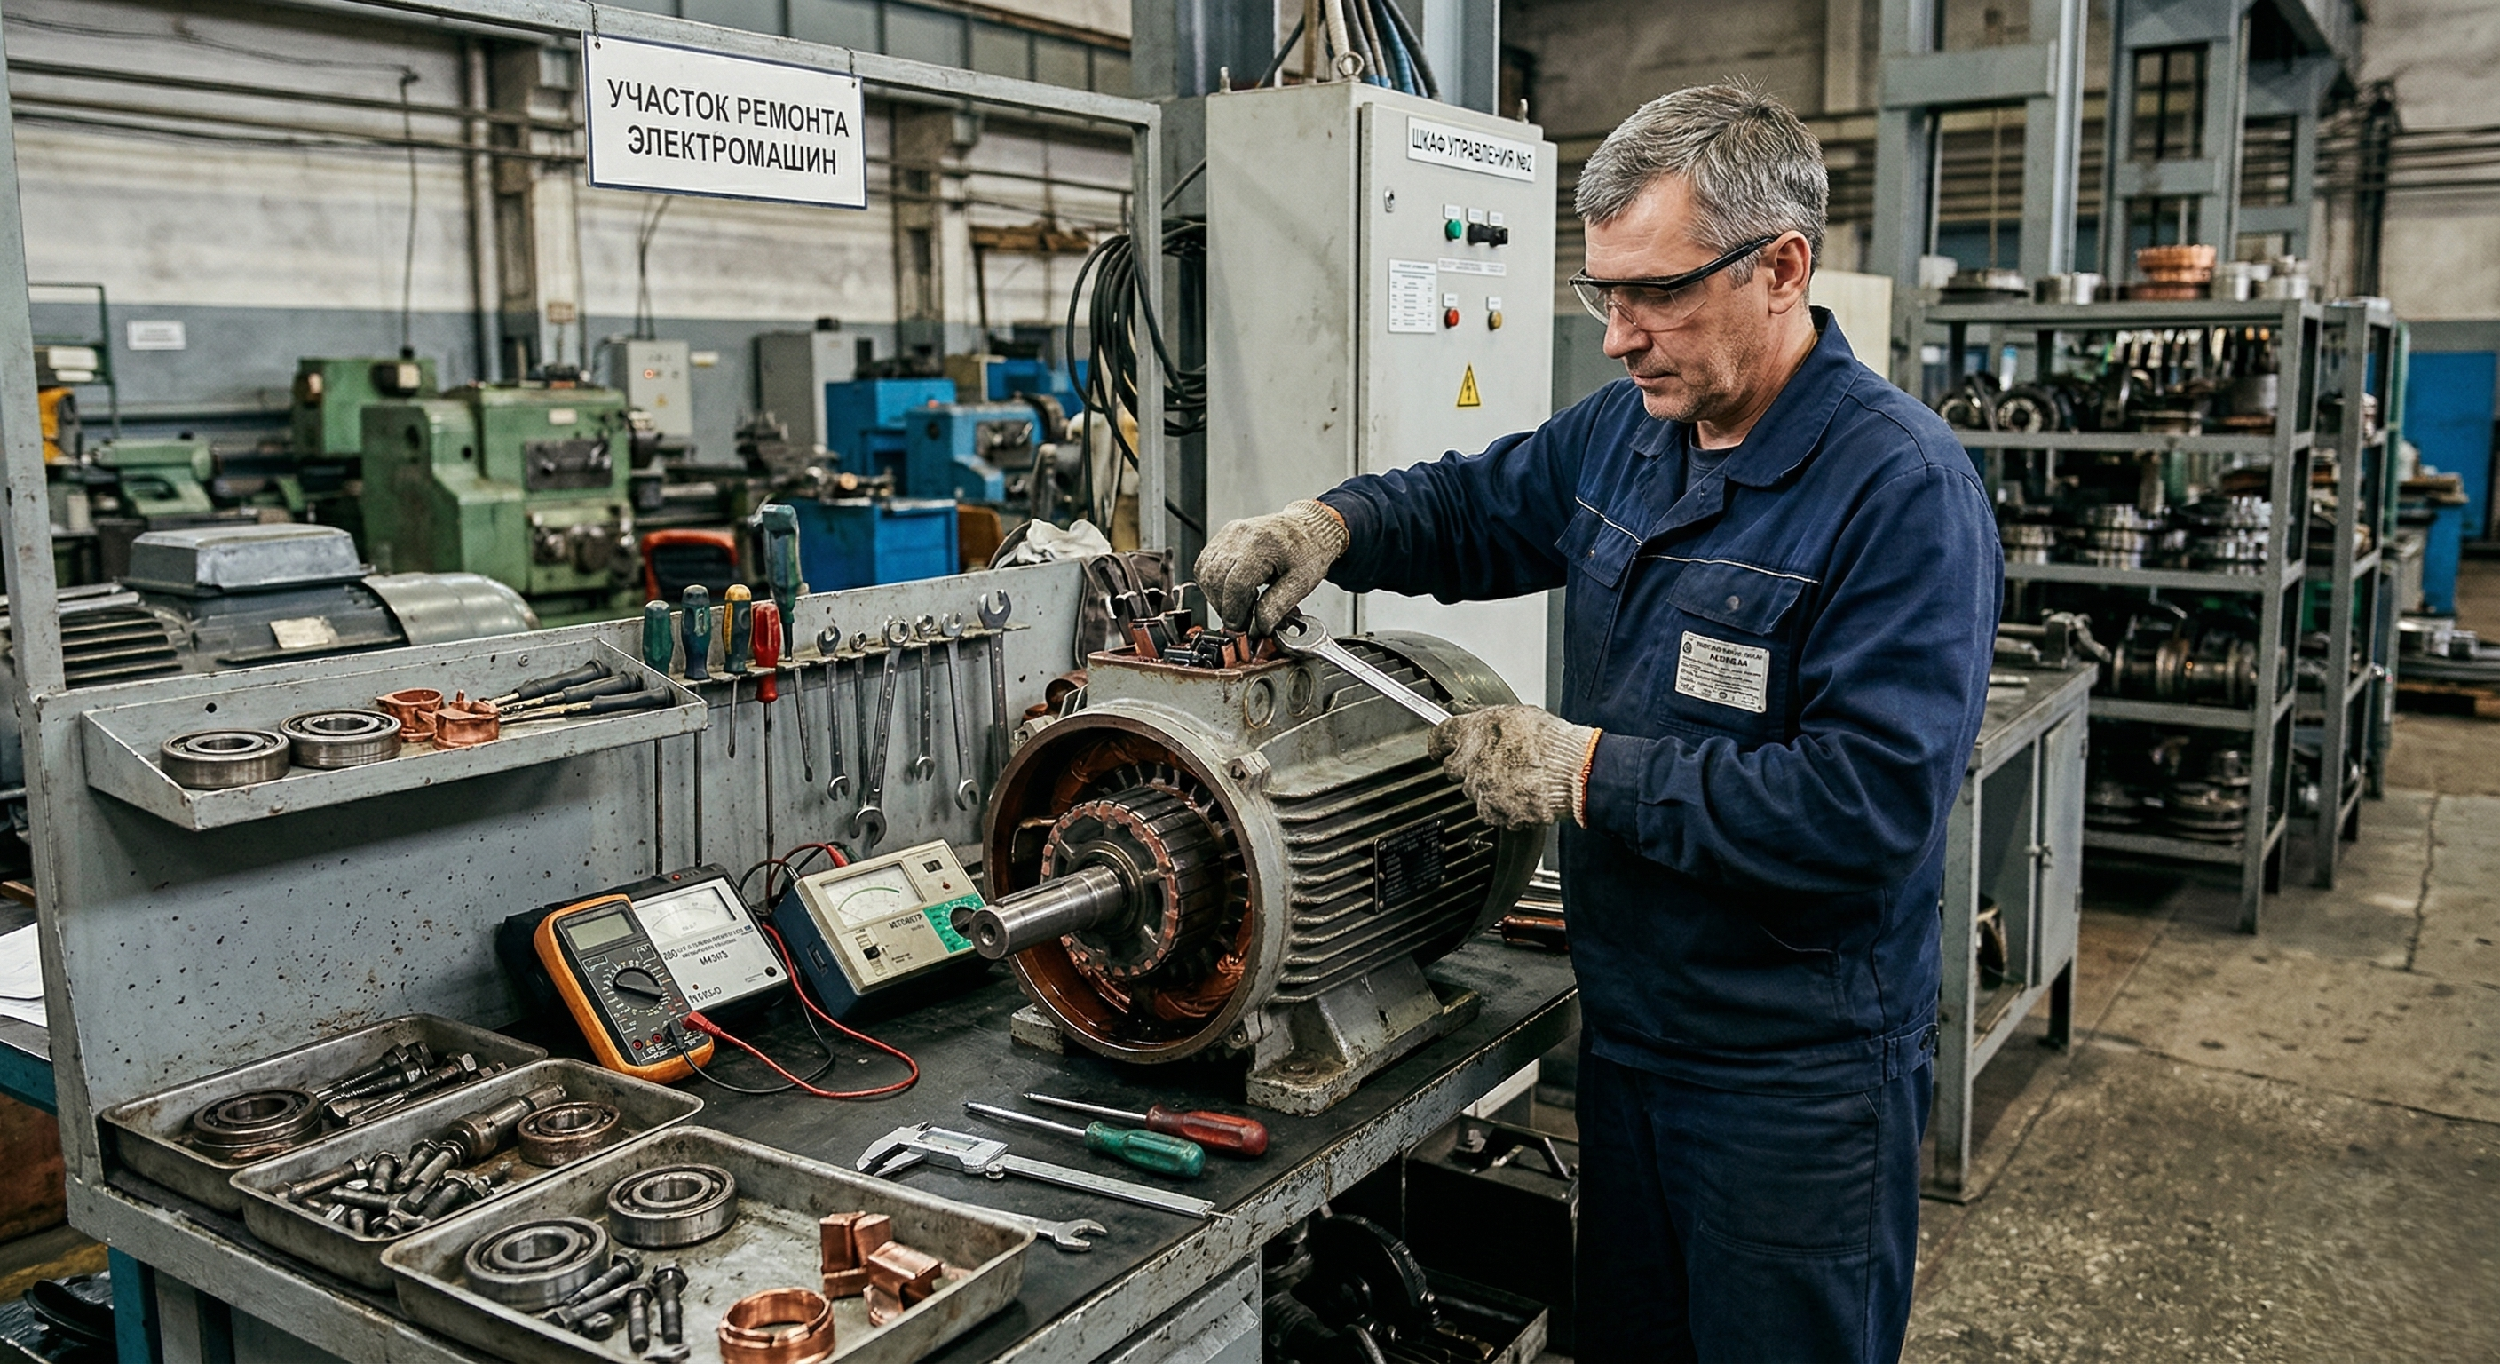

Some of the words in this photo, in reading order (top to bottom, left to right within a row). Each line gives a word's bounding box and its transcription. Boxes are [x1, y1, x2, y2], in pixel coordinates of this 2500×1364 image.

[606, 78, 729, 122] УЧАСТОК
[737, 97, 850, 138] РЕМОНТА
[627, 125, 836, 175] ЭЛЕКТРОМАШИН
[1412, 128, 1446, 153] ШКАФ
[1447, 135, 1514, 169] УПРАВЛЕНИЯ
